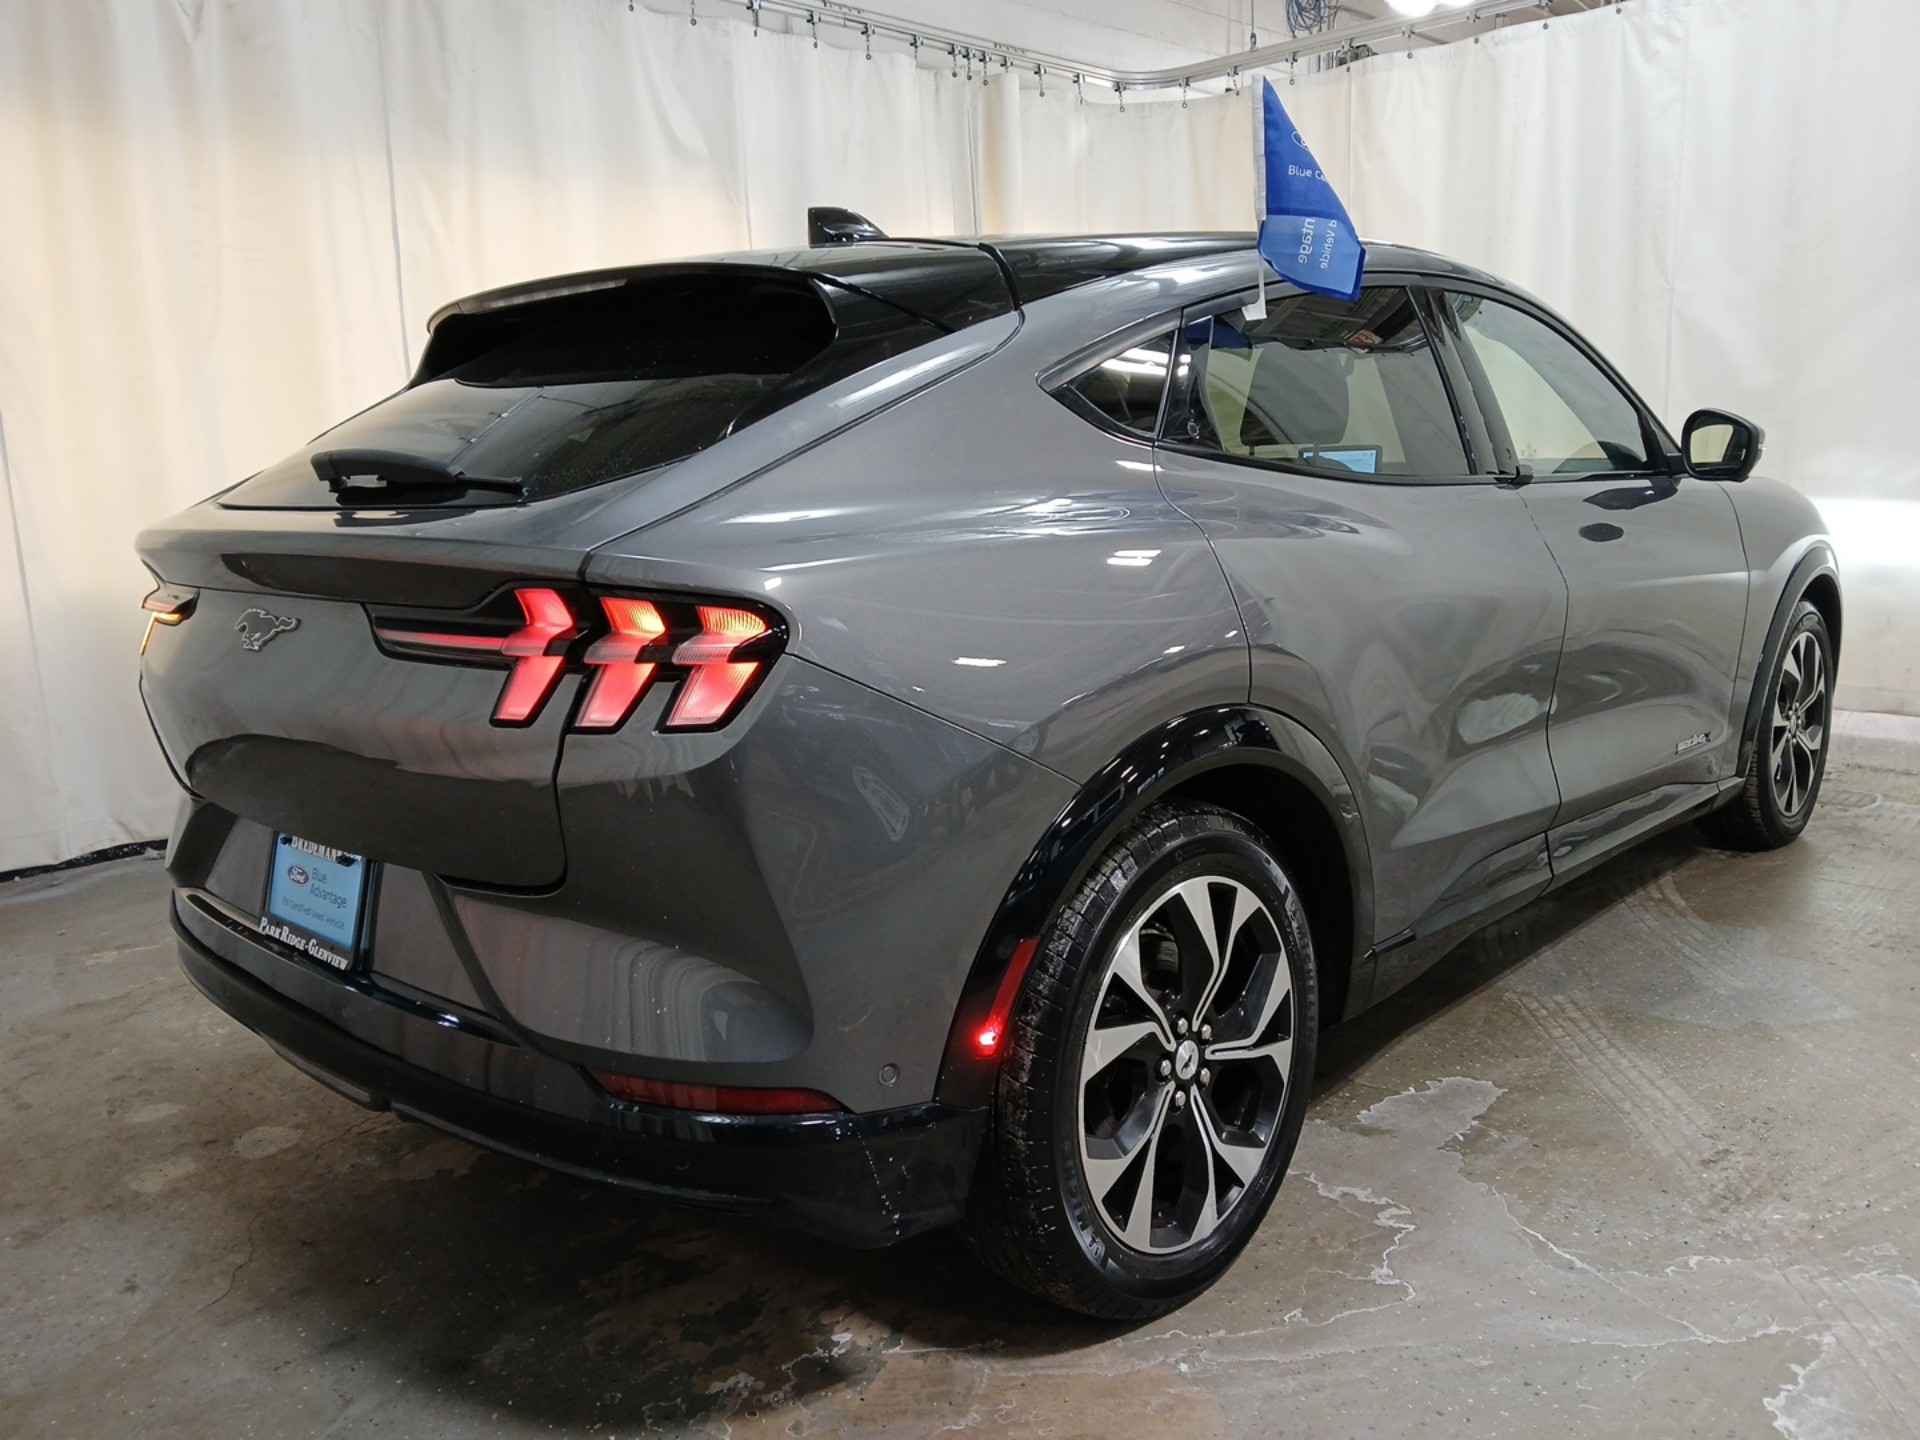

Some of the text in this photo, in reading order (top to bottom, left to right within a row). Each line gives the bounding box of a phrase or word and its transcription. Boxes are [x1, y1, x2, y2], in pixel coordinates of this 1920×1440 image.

[1288, 164, 1313, 178] Blue
[311, 867, 327, 884] Blue
[309, 883, 347, 909] Advantage
